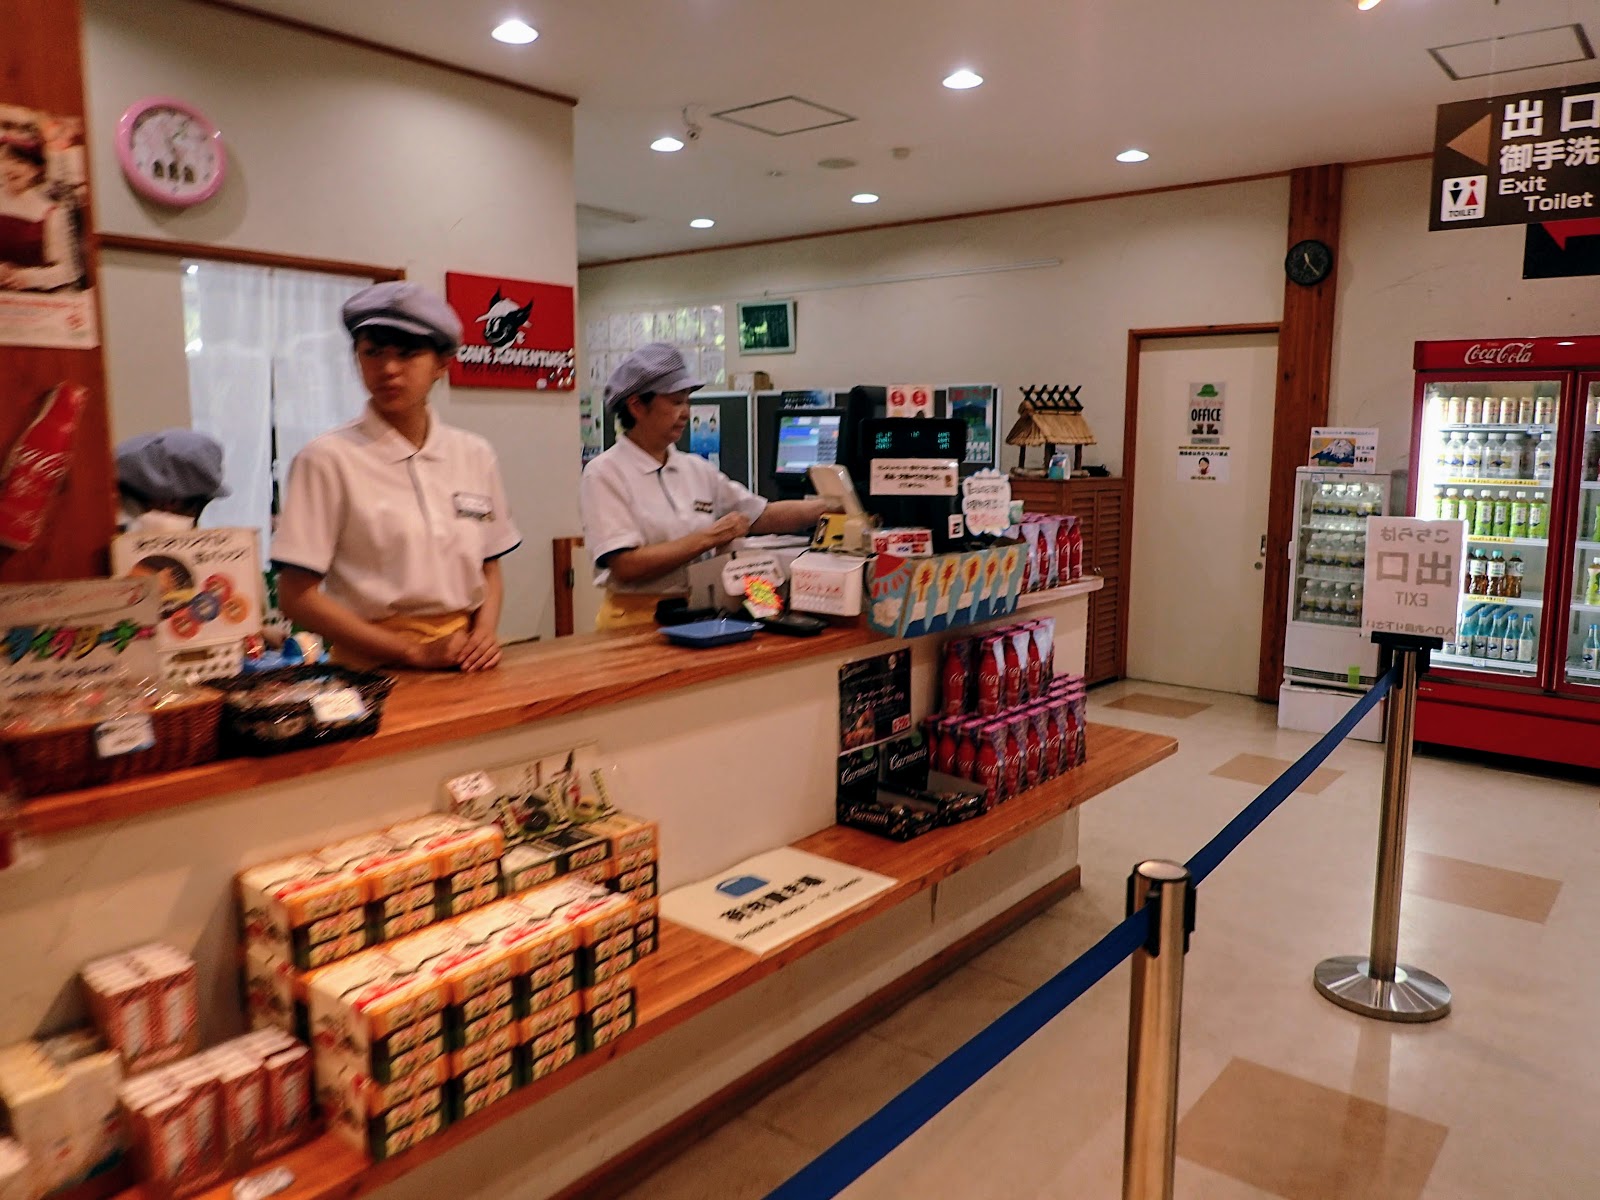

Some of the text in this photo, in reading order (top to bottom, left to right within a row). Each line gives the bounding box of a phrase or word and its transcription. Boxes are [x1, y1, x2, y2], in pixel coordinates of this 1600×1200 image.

[1502, 92, 1600, 140] 出口
[1499, 136, 1600, 174] 御手洗
[1499, 176, 1547, 195] Exit
[1449, 208, 1477, 218] TOILET
[1523, 191, 1594, 212] Toilet
[1464, 342, 1535, 365] Coca-Cola
[1191, 408, 1221, 421] OFFICE
[889, 746, 928, 771] Carman's
[841, 759, 878, 785] Carman's
